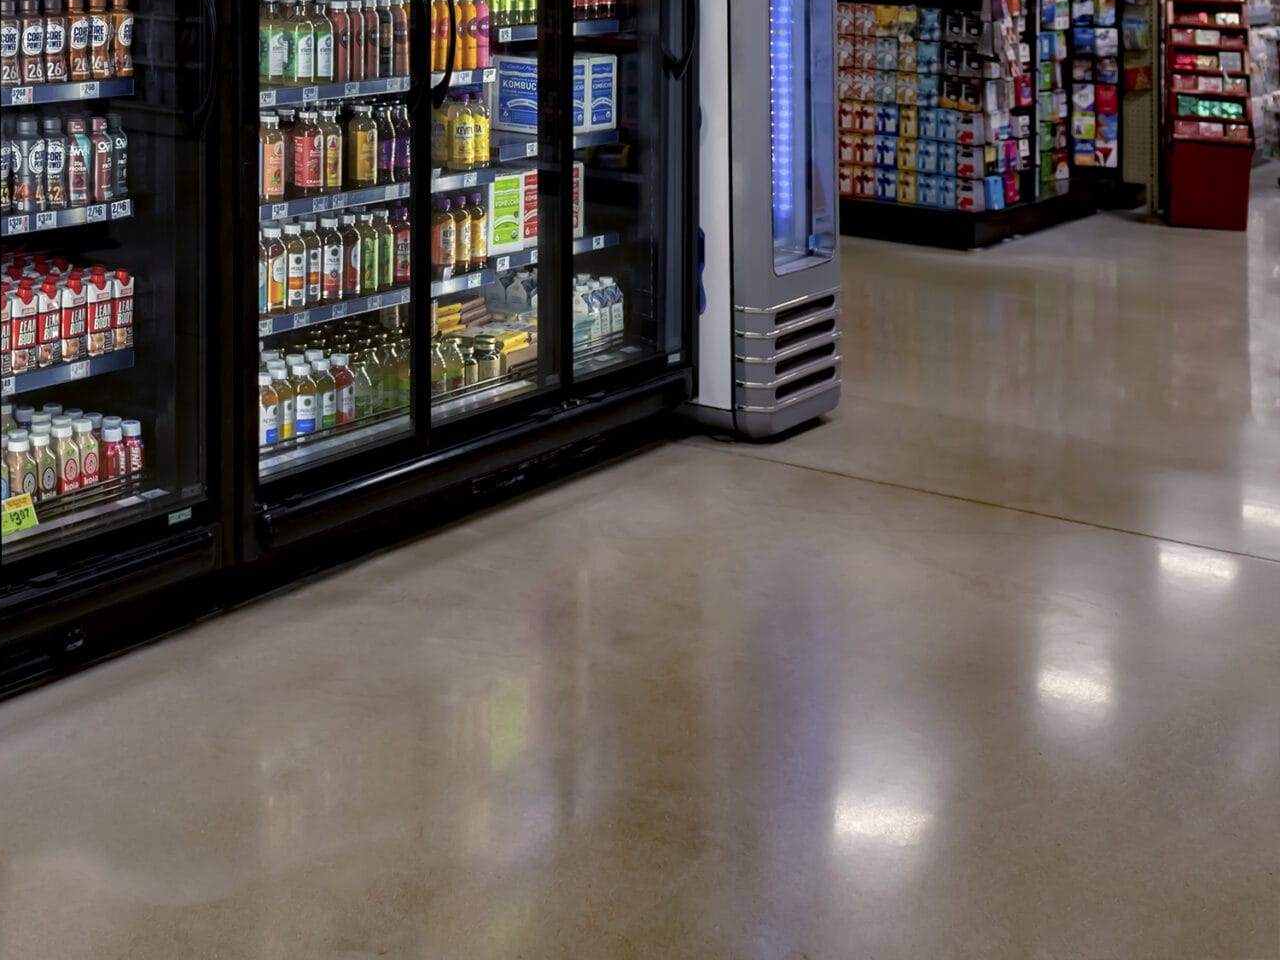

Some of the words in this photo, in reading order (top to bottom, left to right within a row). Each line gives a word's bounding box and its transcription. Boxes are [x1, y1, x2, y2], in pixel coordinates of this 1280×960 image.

[71, 309, 86, 322] LEAN
[95, 304, 111, 317] LEAN
[20, 319, 37, 331] LEAN
[70, 321, 85, 336] BODY
[94, 316, 110, 330] BODY
[18, 332, 35, 346] BODY
